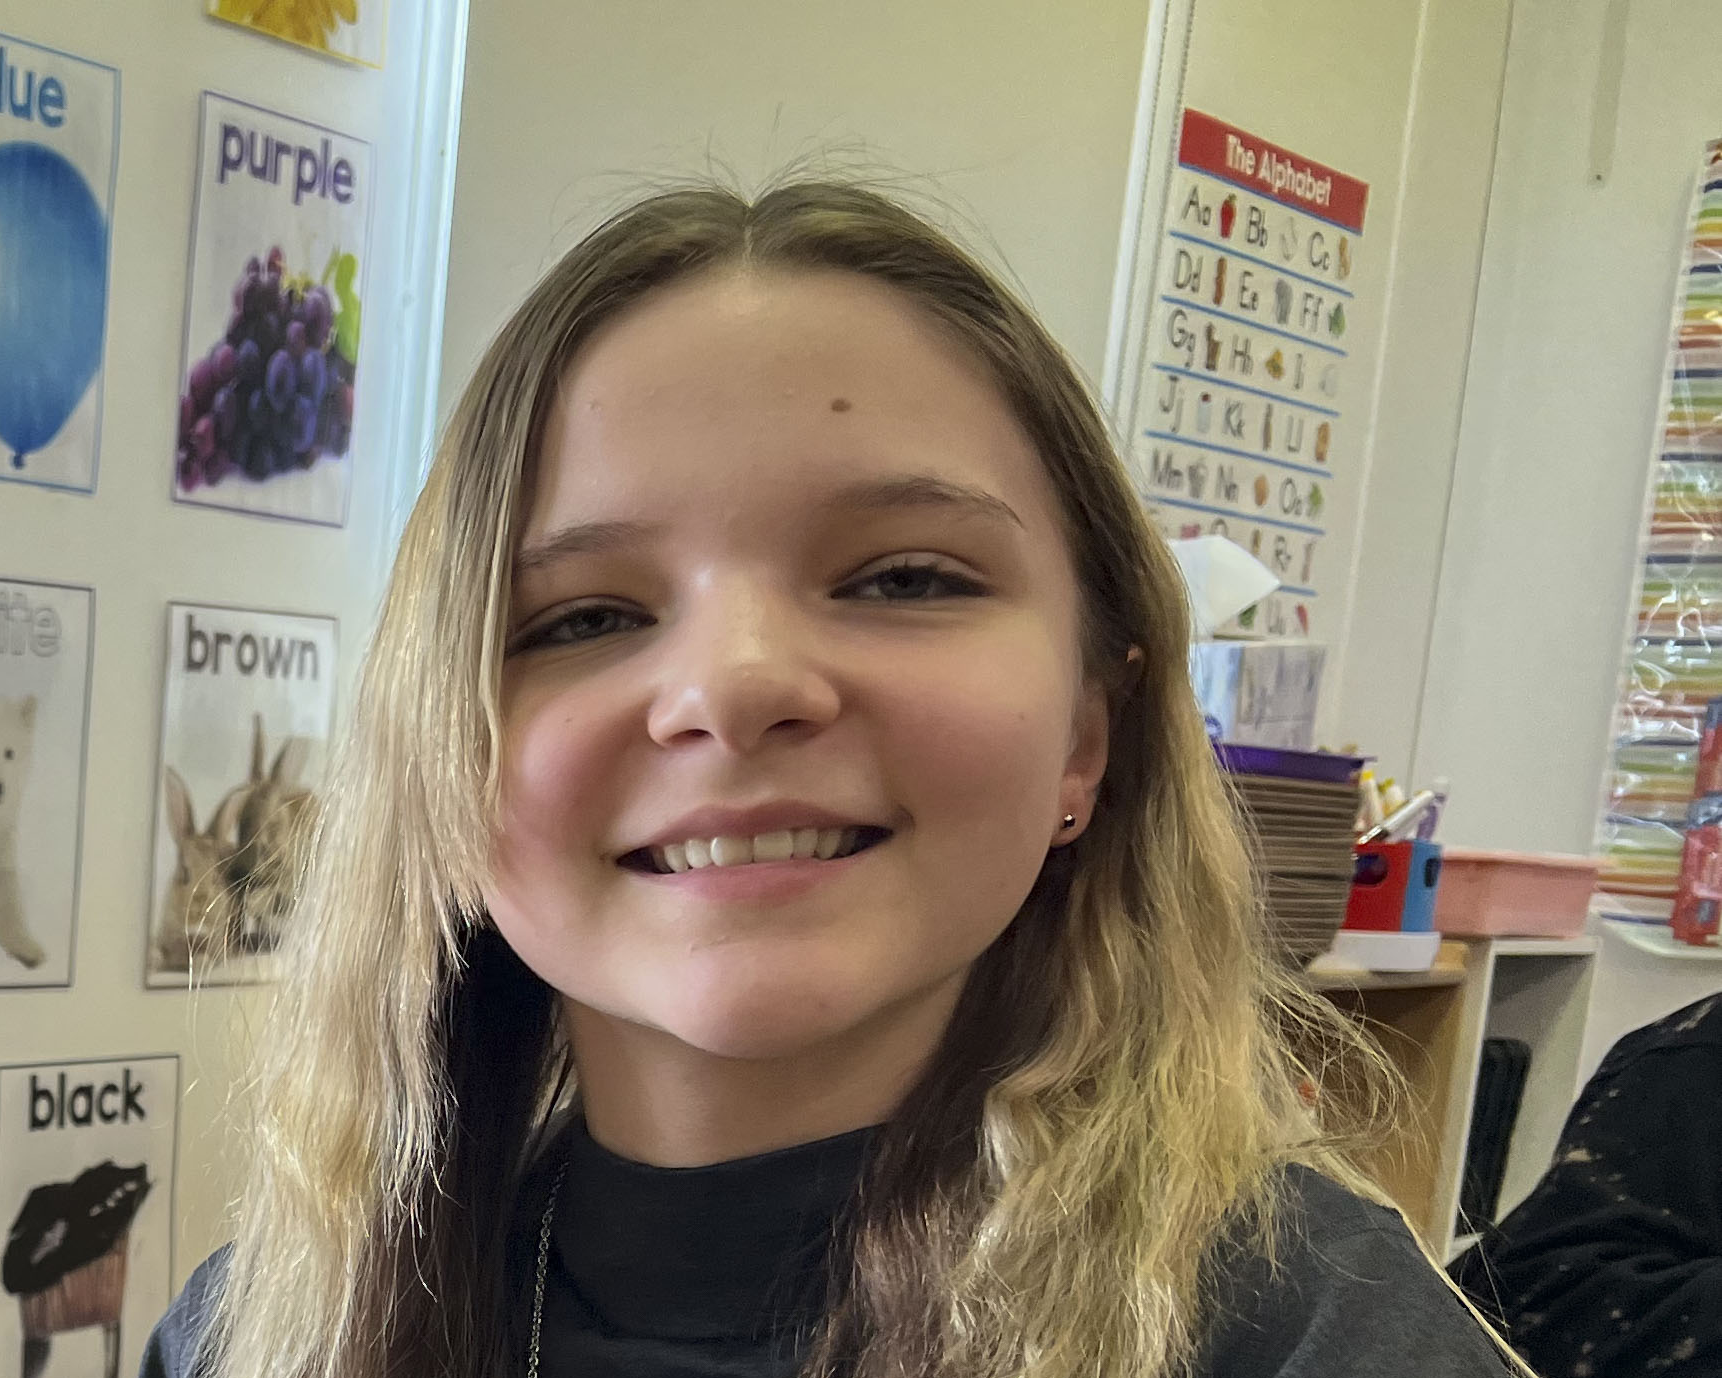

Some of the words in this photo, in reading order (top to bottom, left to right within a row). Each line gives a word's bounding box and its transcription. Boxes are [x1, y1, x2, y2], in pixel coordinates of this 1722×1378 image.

[216, 118, 358, 206] purple
[1225, 134, 1256, 176] The
[1258, 149, 1333, 207] Alphabet
[1246, 205, 1269, 250] Bb
[1309, 231, 1331, 271] Cc
[1174, 248, 1203, 294] Dd
[1239, 270, 1260, 312] Ee
[183, 613, 321, 682] brown
[28, 1068, 147, 1133] black
